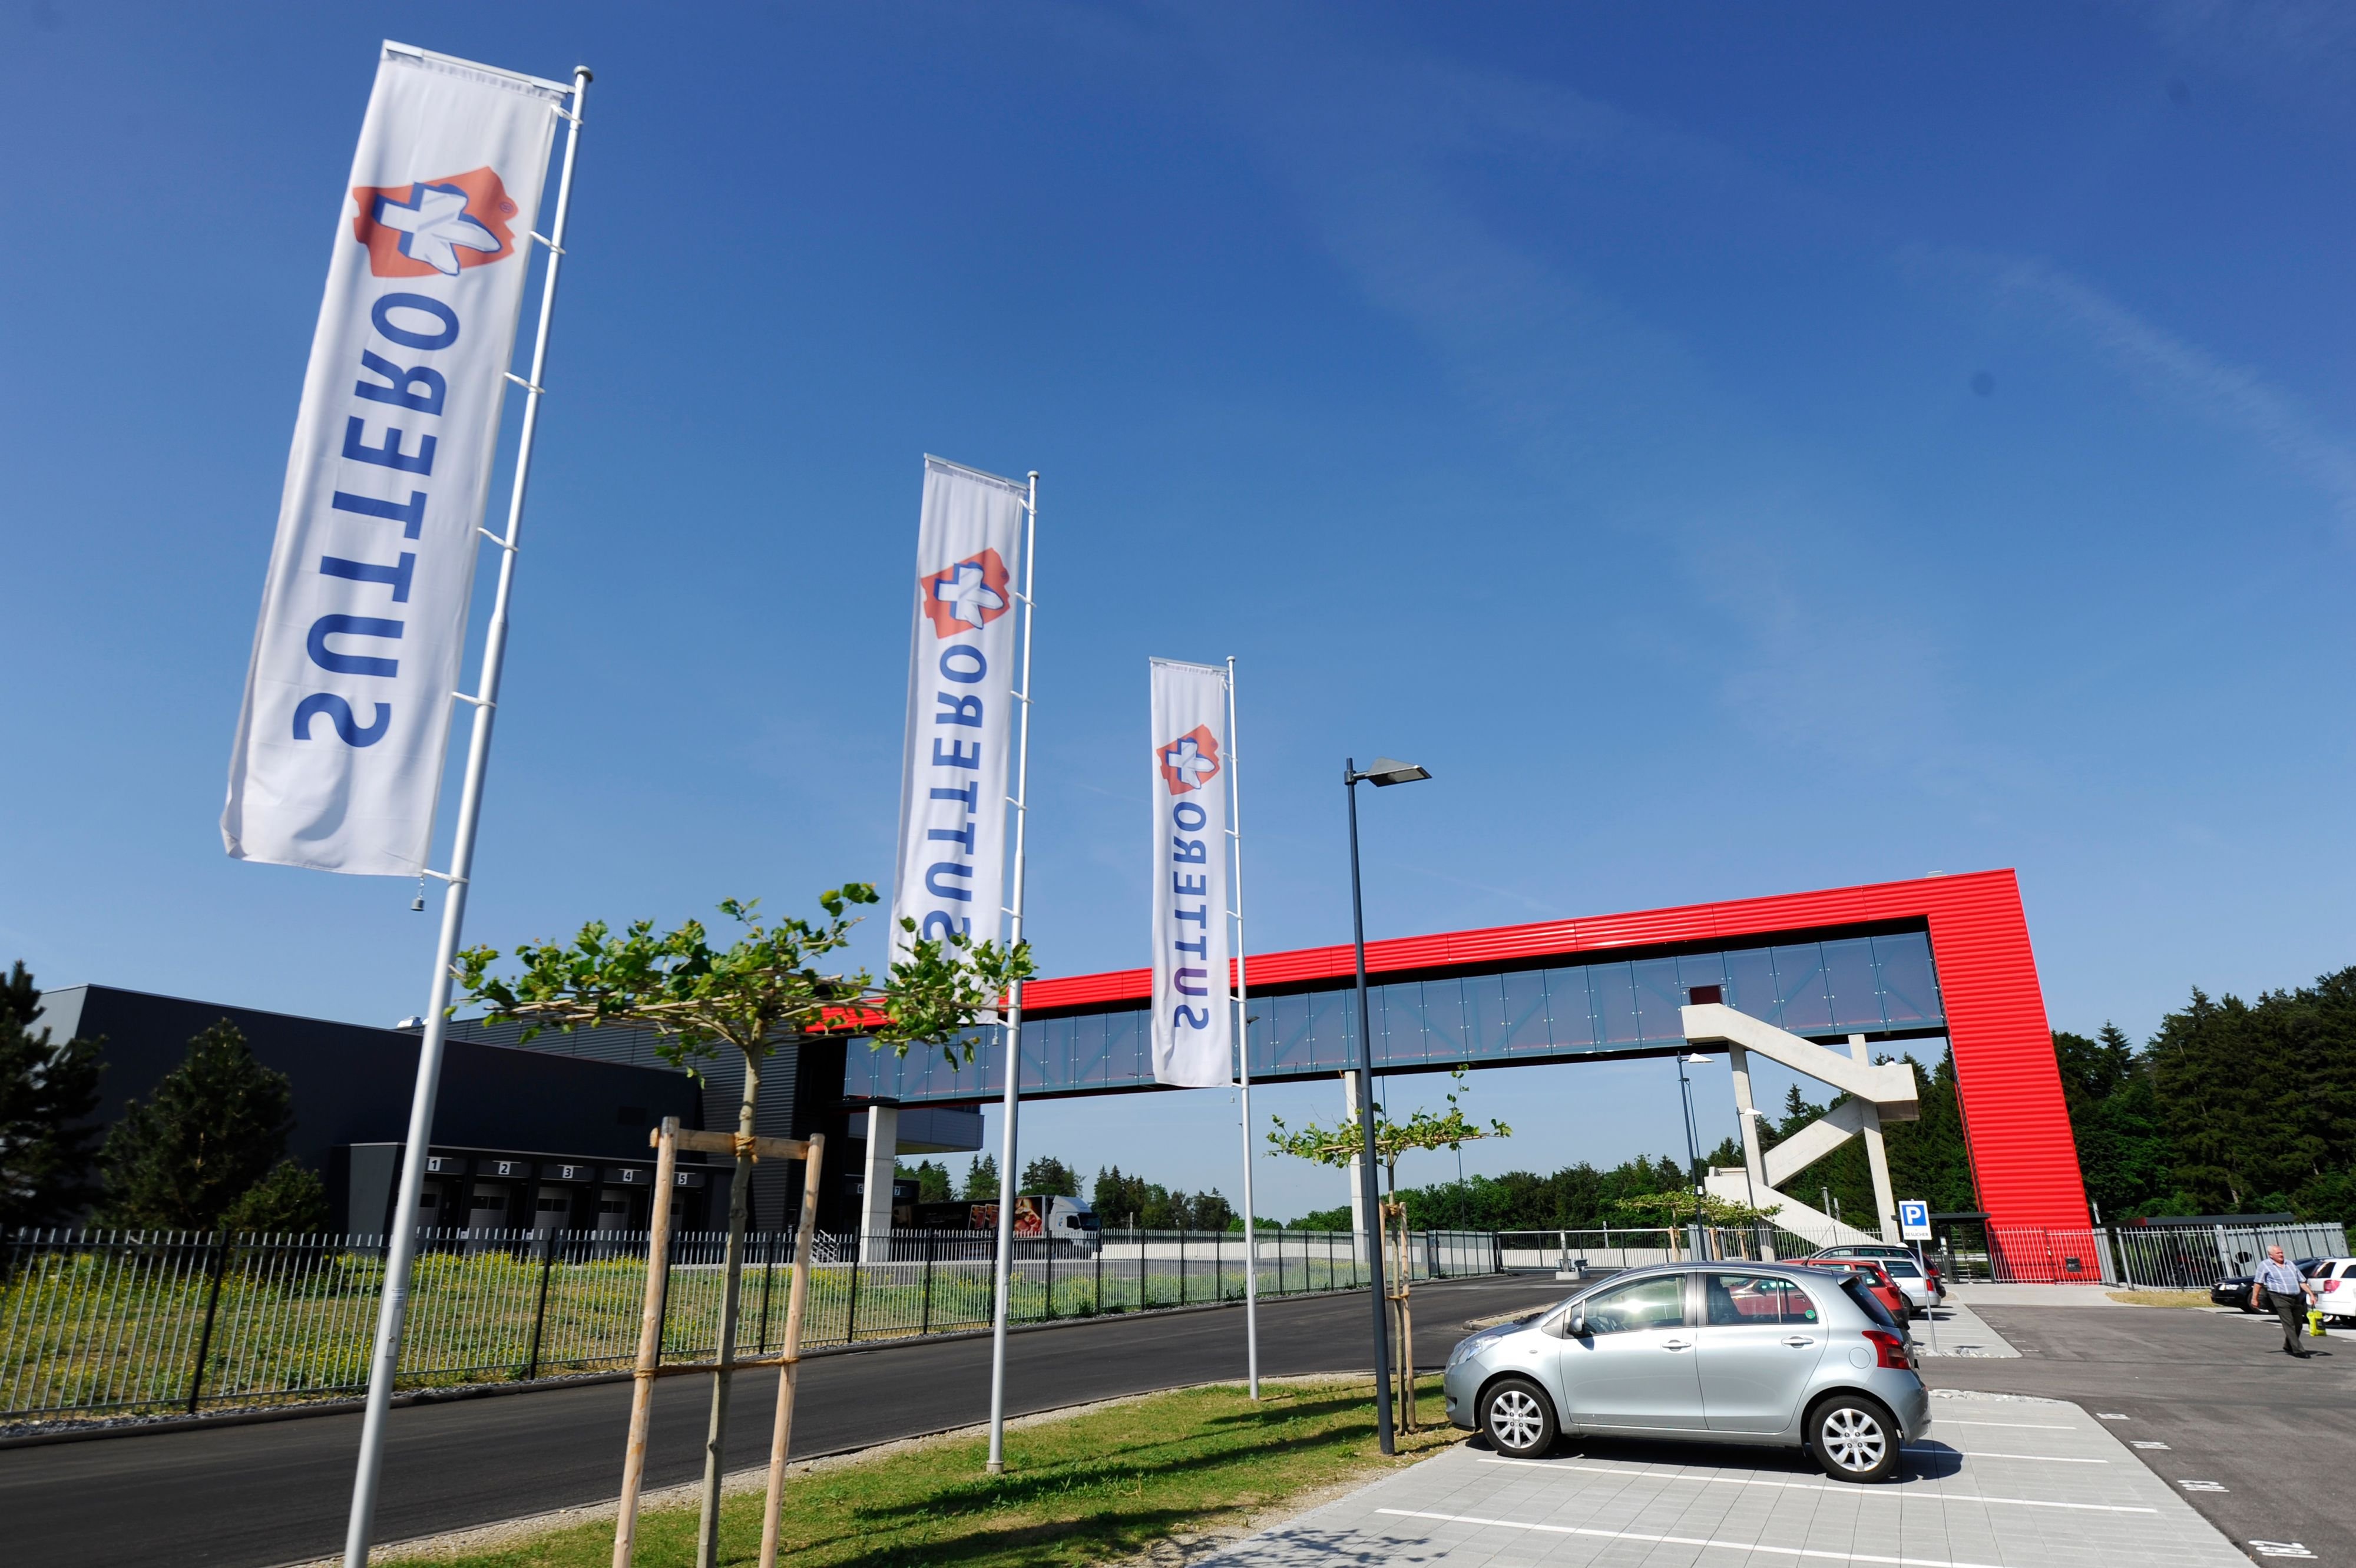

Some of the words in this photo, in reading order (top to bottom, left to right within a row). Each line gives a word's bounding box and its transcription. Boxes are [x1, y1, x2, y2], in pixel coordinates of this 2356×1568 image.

[431, 1160, 438, 1170] 1
[501, 1164, 508, 1174] 2
[564, 1168, 571, 1177] 3
[625, 1172, 631, 1180] 4
[680, 1175, 686, 1183] 5
[1905, 1206, 1921, 1225] P
[2176, 1480, 2230, 1492] 183
[2248, 1540, 2319, 1559] 182
